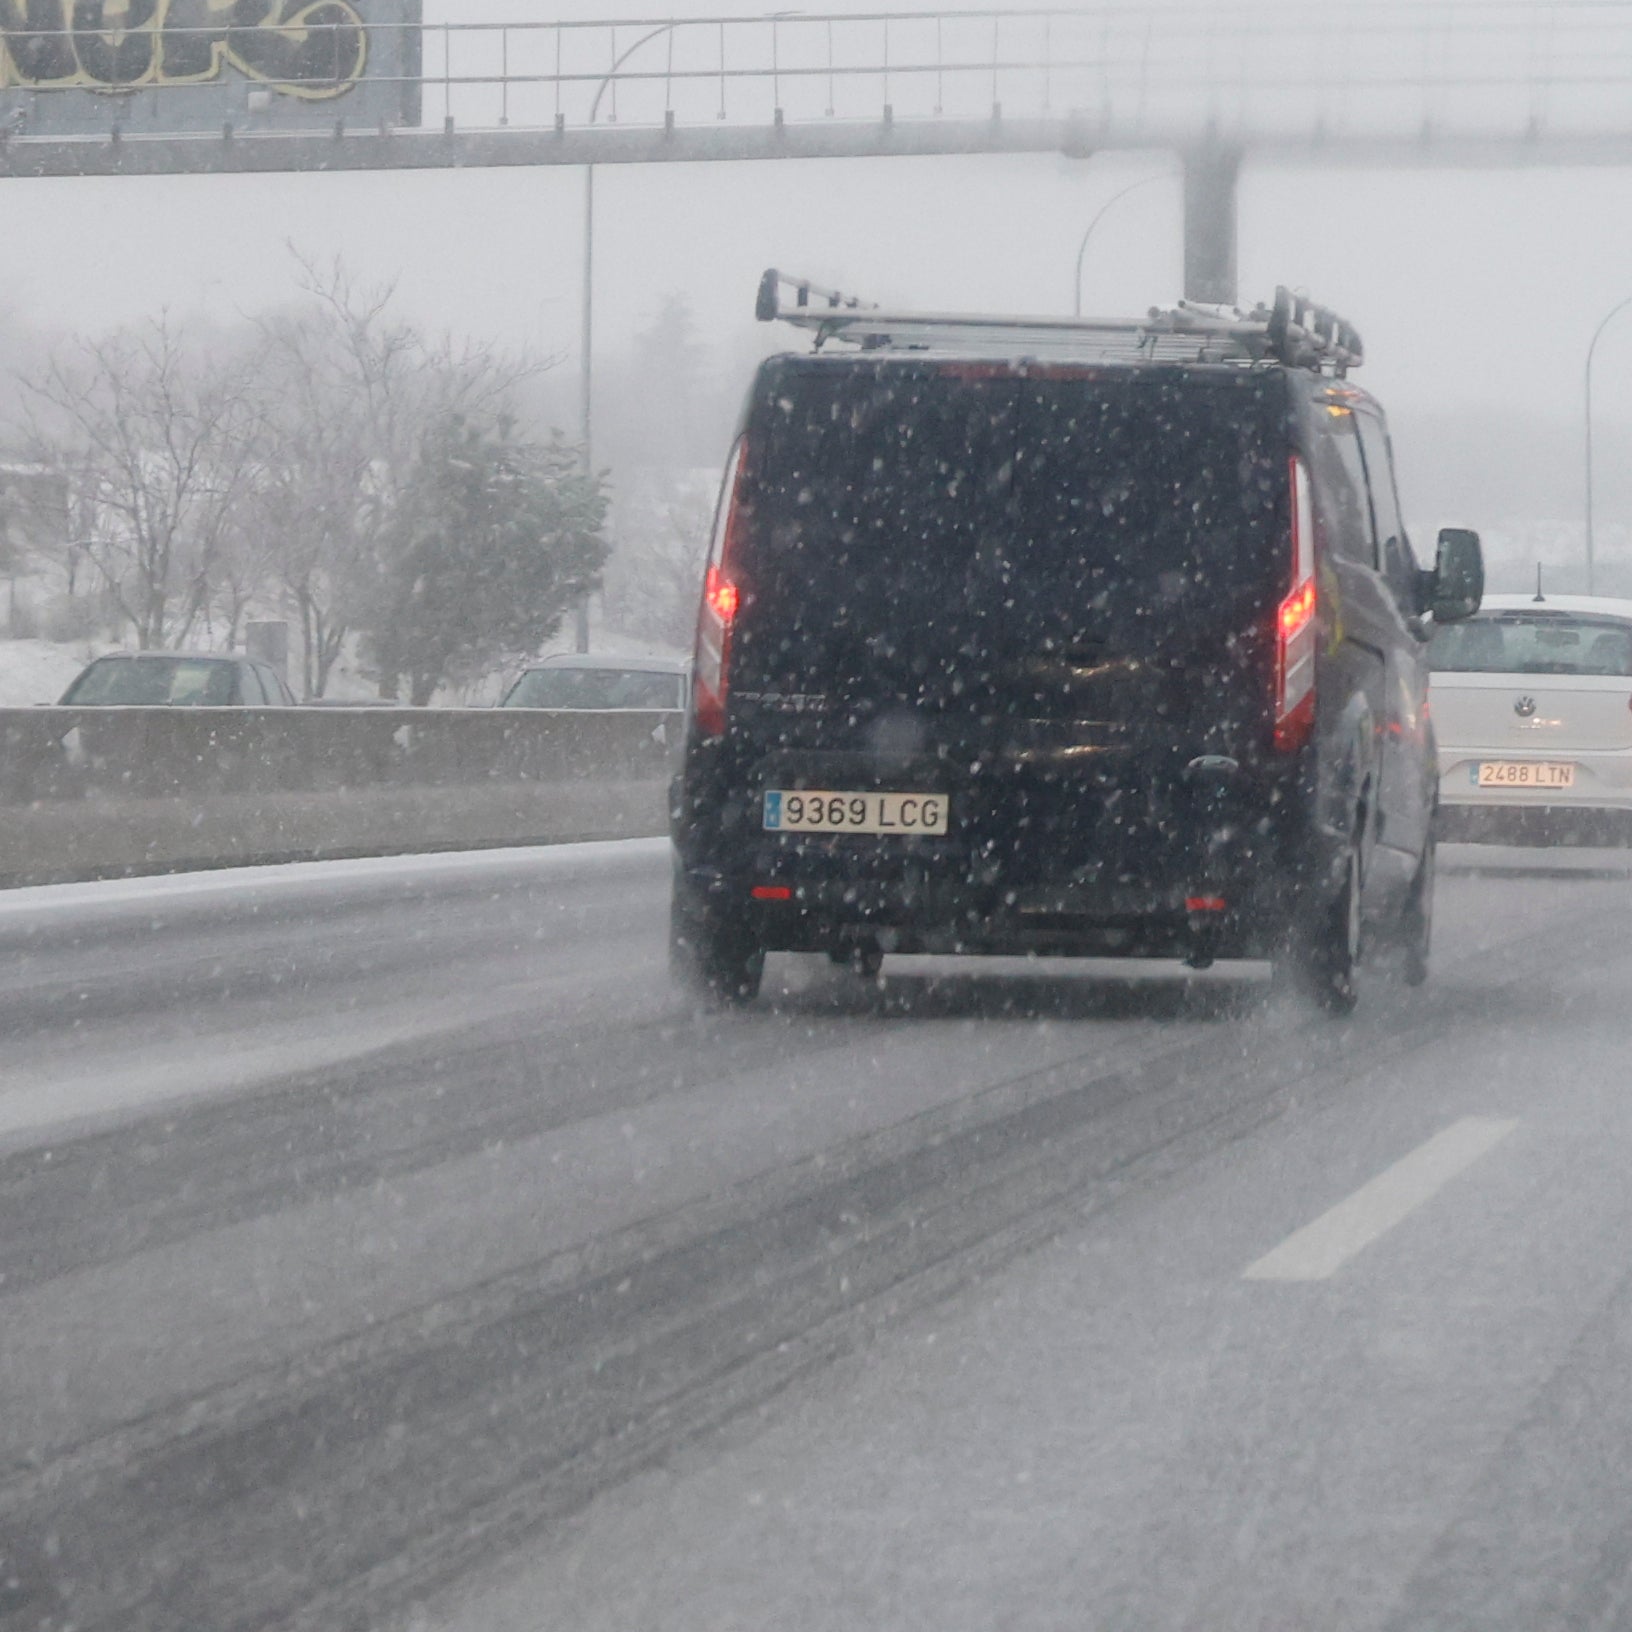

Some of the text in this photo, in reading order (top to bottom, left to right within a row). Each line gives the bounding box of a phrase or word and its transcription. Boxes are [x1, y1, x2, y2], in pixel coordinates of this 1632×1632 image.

[1535, 767, 1571, 783] LTN
[786, 795, 939, 827] 9369 LCG
